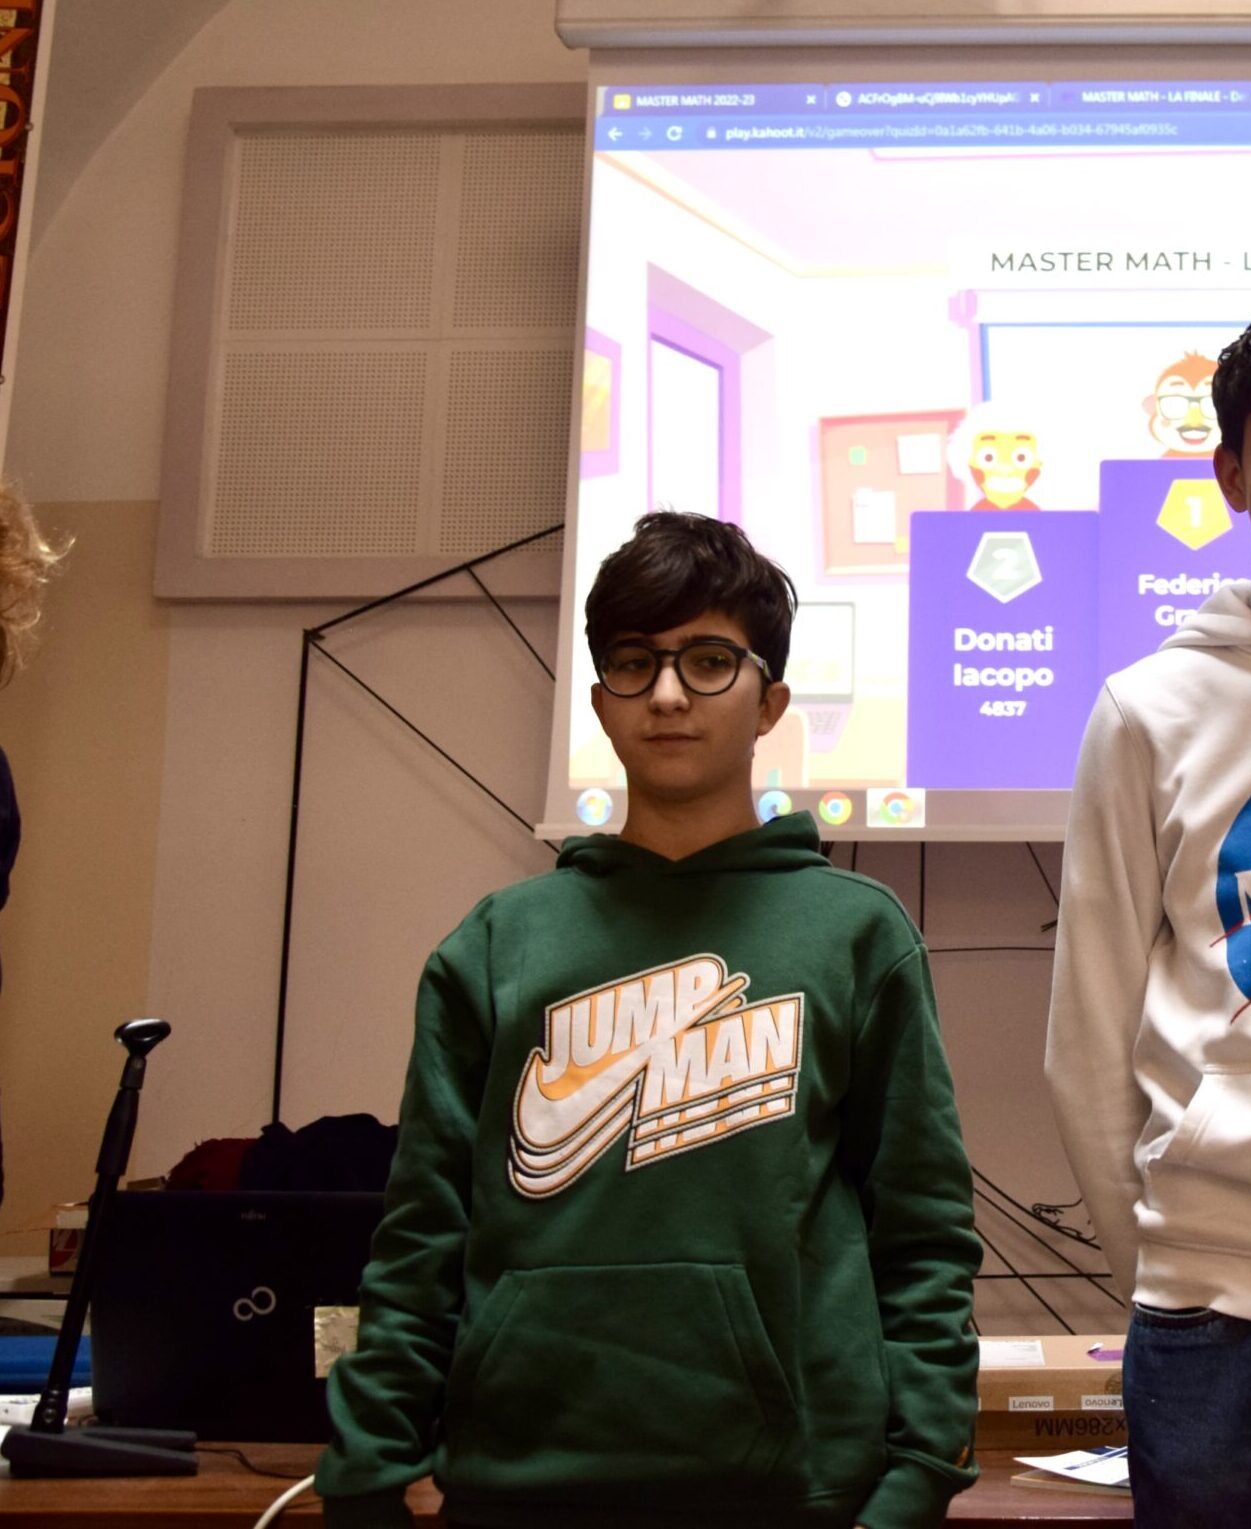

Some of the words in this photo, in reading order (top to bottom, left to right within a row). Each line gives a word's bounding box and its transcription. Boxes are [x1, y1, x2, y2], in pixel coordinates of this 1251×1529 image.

[636, 94, 678, 106] MASTER
[681, 94, 711, 106] MATH
[1082, 91, 1125, 103] MASTER
[1127, 91, 1158, 103] MATH
[1168, 91, 1182, 102] LA
[990, 251, 1114, 272] MASTER
[1125, 251, 1211, 271] MATH
[1185, 495, 1201, 529] 1
[991, 547, 1019, 581] 2
[953, 626, 1054, 652] Donati
[953, 663, 1055, 692] Iacopo
[979, 700, 1028, 717] 4837
[541, 958, 724, 1085] JUMP
[640, 1000, 798, 1118] MAN
[1012, 1399, 1050, 1410] Lenovo
